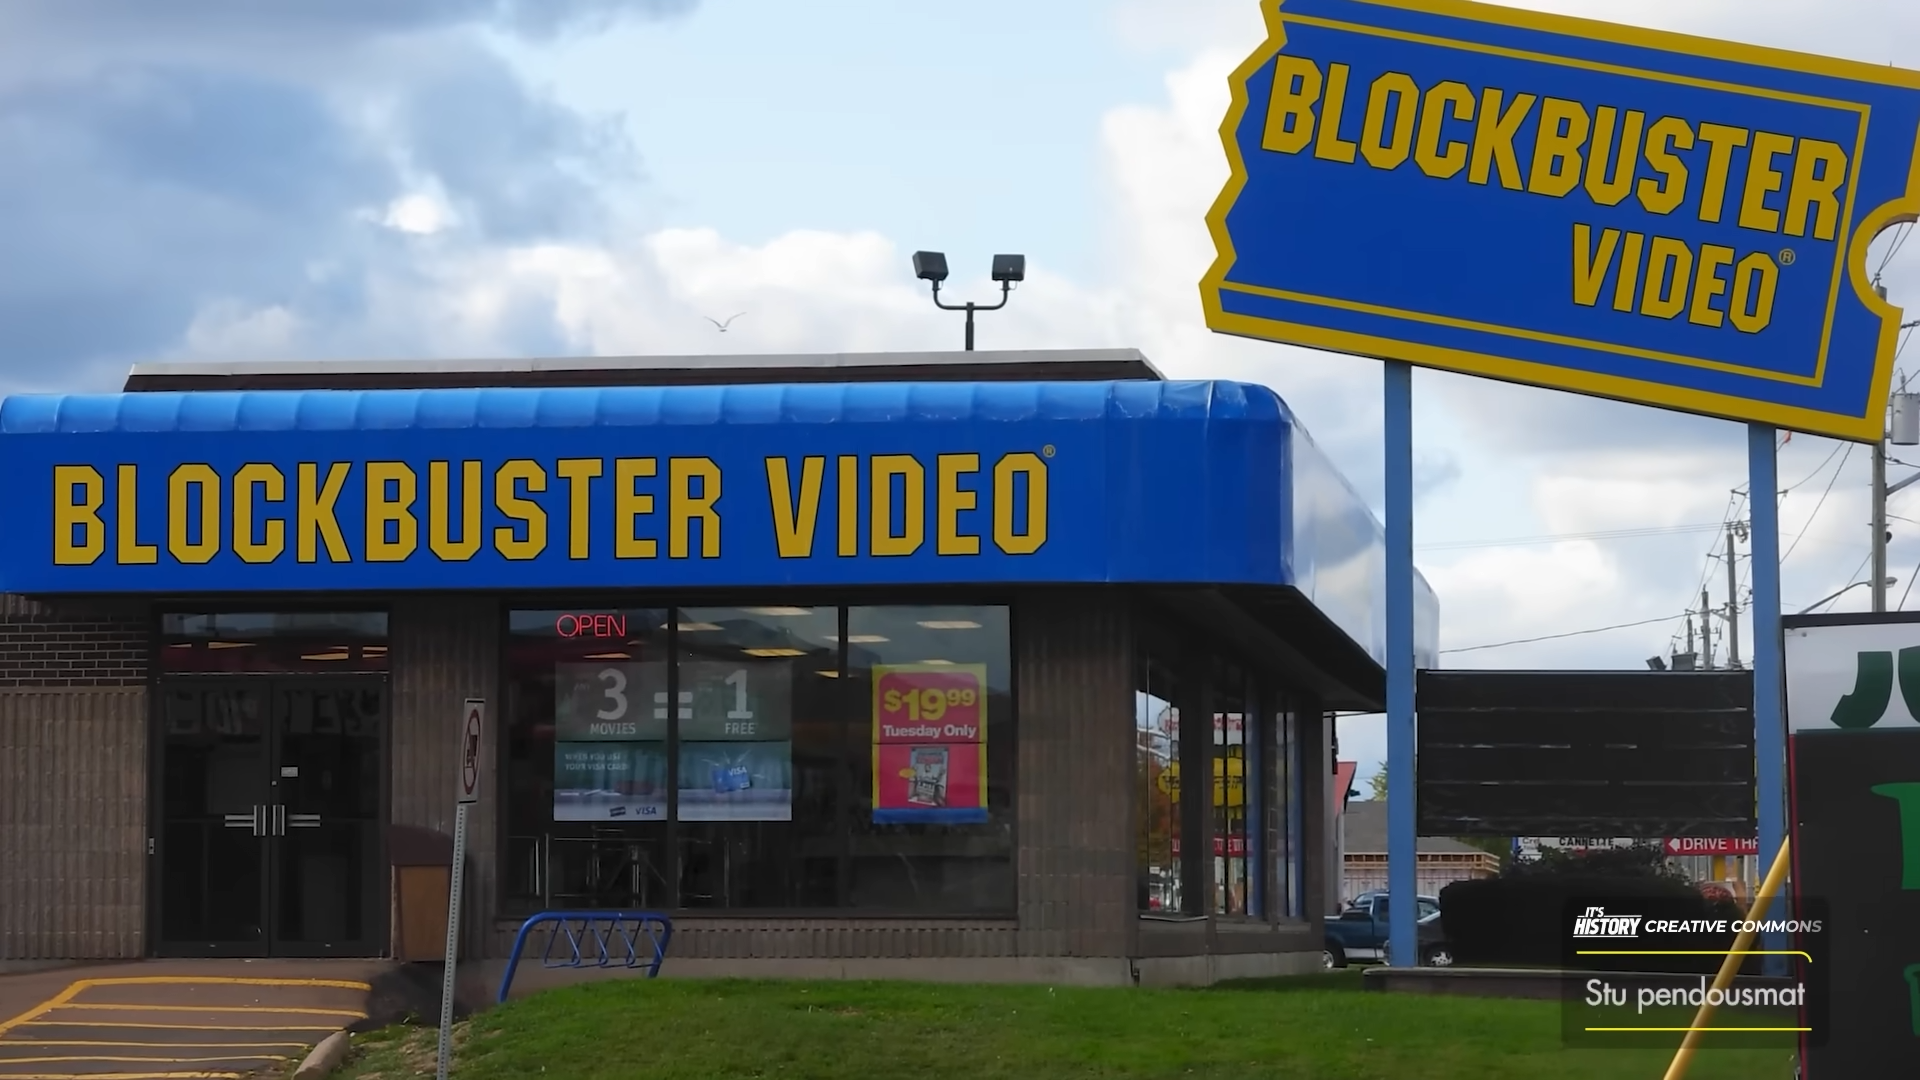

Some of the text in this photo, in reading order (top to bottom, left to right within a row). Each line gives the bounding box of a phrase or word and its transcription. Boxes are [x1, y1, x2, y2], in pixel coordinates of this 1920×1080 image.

[1261, 54, 1849, 242] BLOCKBUSTER
[53, 455, 723, 566] BLOCKBUSTER
[556, 614, 626, 638] OPEN
[596, 667, 628, 721] 3
[724, 668, 754, 720] 1
[590, 722, 636, 736] MOVIES
[724, 722, 756, 735] FREE
[883, 724, 977, 739] Tuesday Only
[728, 766, 747, 776] VISA
[635, 806, 657, 815] VISA
[1683, 838, 1727, 850] DRIVE
